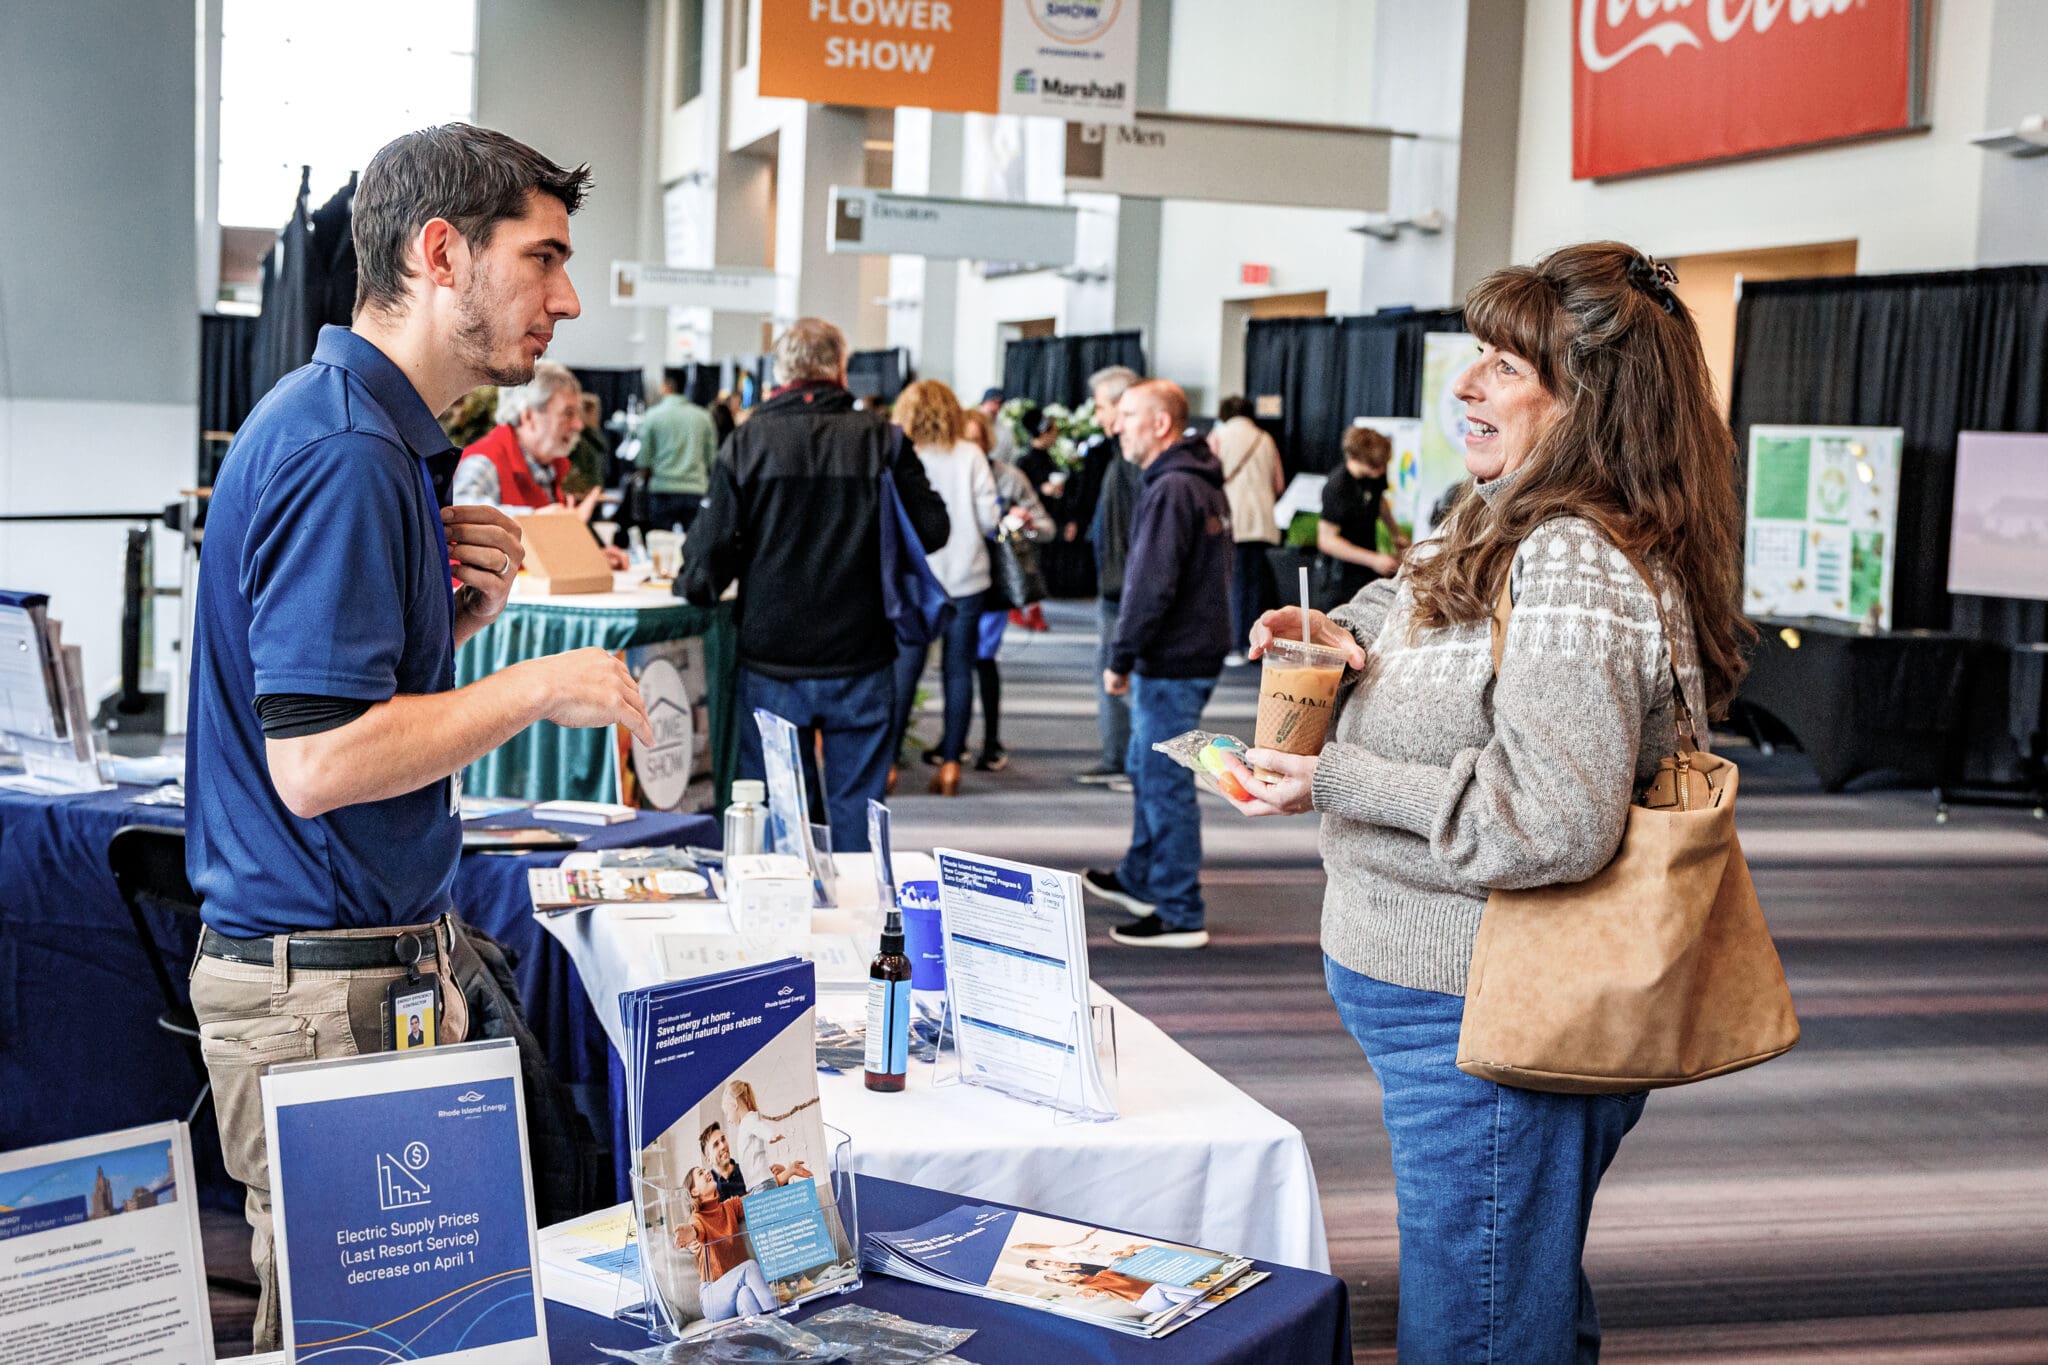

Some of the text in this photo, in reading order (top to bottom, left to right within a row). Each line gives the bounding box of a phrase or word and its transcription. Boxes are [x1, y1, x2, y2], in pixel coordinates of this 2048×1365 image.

[809, 0, 952, 30] FLOWER
[1047, 3, 1098, 18] SHOW
[824, 37, 935, 73] SHOW
[1042, 78, 1125, 99] Marshall
[1118, 124, 1165, 146] Men
[656, 1015, 762, 1050] residential natural gas rebates
[657, 1025, 675, 1037] Save
[676, 1020, 701, 1033] energy
[702, 1016, 710, 1026] at
[710, 1012, 730, 1024] home
[438, 1109, 460, 1118] Rhode
[461, 1106, 481, 1115] Island
[482, 1103, 507, 1113] Energy
[336, 1212, 480, 1245] Electric Supply Prices
[15, 1239, 103, 1264] Customer Service Associate
[341, 1229, 480, 1267] (Last Resort Service)
[347, 1250, 474, 1285] decrease on April 1
